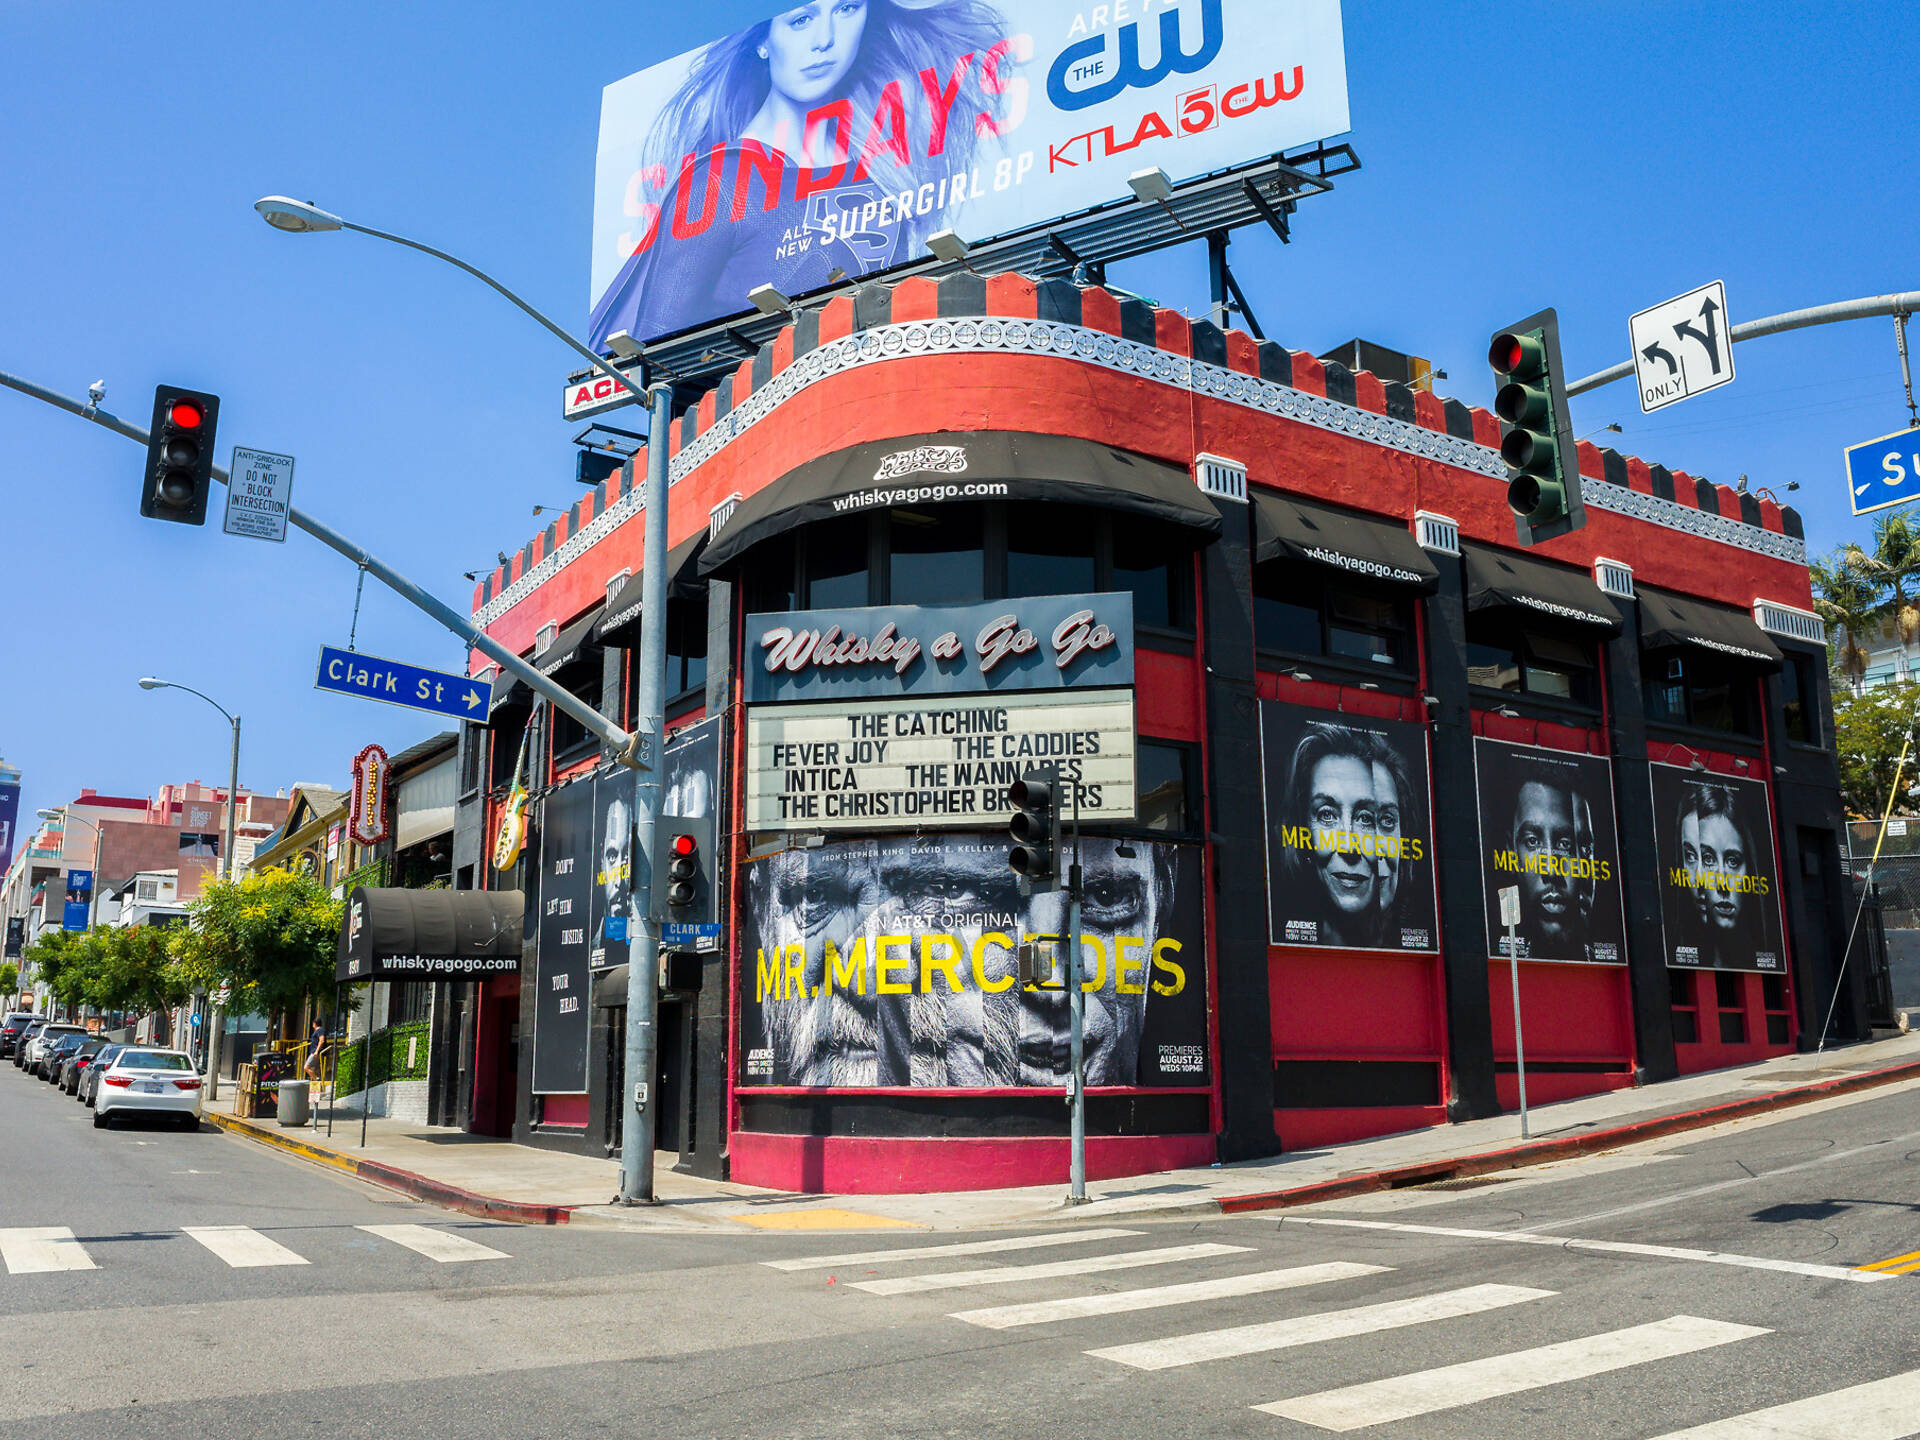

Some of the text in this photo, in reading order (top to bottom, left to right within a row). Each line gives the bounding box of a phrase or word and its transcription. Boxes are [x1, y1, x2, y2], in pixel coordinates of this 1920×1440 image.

[1046, 0, 1224, 111] THE CW
[1049, 111, 1173, 173] KTLA
[1180, 89, 1215, 133] 5
[1221, 65, 1304, 118] CW
[617, 33, 1035, 258] SUNDAYS
[820, 150, 1034, 246] SUPERGIRL 8P
[781, 225, 811, 242] ALL
[775, 238, 815, 261] NEW
[1645, 377, 1681, 402] ONLY
[237, 452, 291, 467] ANTI-GRIDLOCK
[253, 462, 272, 471] ZONE
[246, 470, 277, 486] DO NOT
[247, 484, 272, 498] BLOCK
[833, 483, 1008, 511] whiskyagogo.com
[231, 495, 285, 513] INTERSECTION
[1303, 547, 1422, 582] whiskyagogo.com
[761, 609, 1115, 675] Whisky a Go Go
[328, 659, 444, 703] Clark St
[848, 708, 1008, 738] THE CATCHING
[773, 731, 1100, 768] FEVER JOY THE CADDIES
[785, 767, 857, 792] INTICA
[906, 764, 947, 788] THE
[778, 784, 1102, 818] THE CHRISTOPHER BRERS
[822, 853, 840, 862] FROM
[843, 850, 878, 860] STEPHEN
[882, 848, 904, 856] KING
[911, 846, 941, 854] DAVID
[958, 845, 994, 853] KELLEY
[555, 858, 574, 875] DON'T
[546, 898, 572, 916] LET HIM
[670, 924, 701, 935] CLARK
[865, 913, 1023, 929] AN AT&T ORIGINAL
[561, 929, 583, 945] INSIDE
[382, 955, 517, 973] whiskyagogo.com
[552, 974, 569, 991] YOUR
[559, 996, 579, 1014] HEAD.
[1158, 1045, 1203, 1055] PREMIERES
[1160, 1056, 1203, 1064] AUGUST 22
[1160, 1064, 1180, 1072] WEDS
